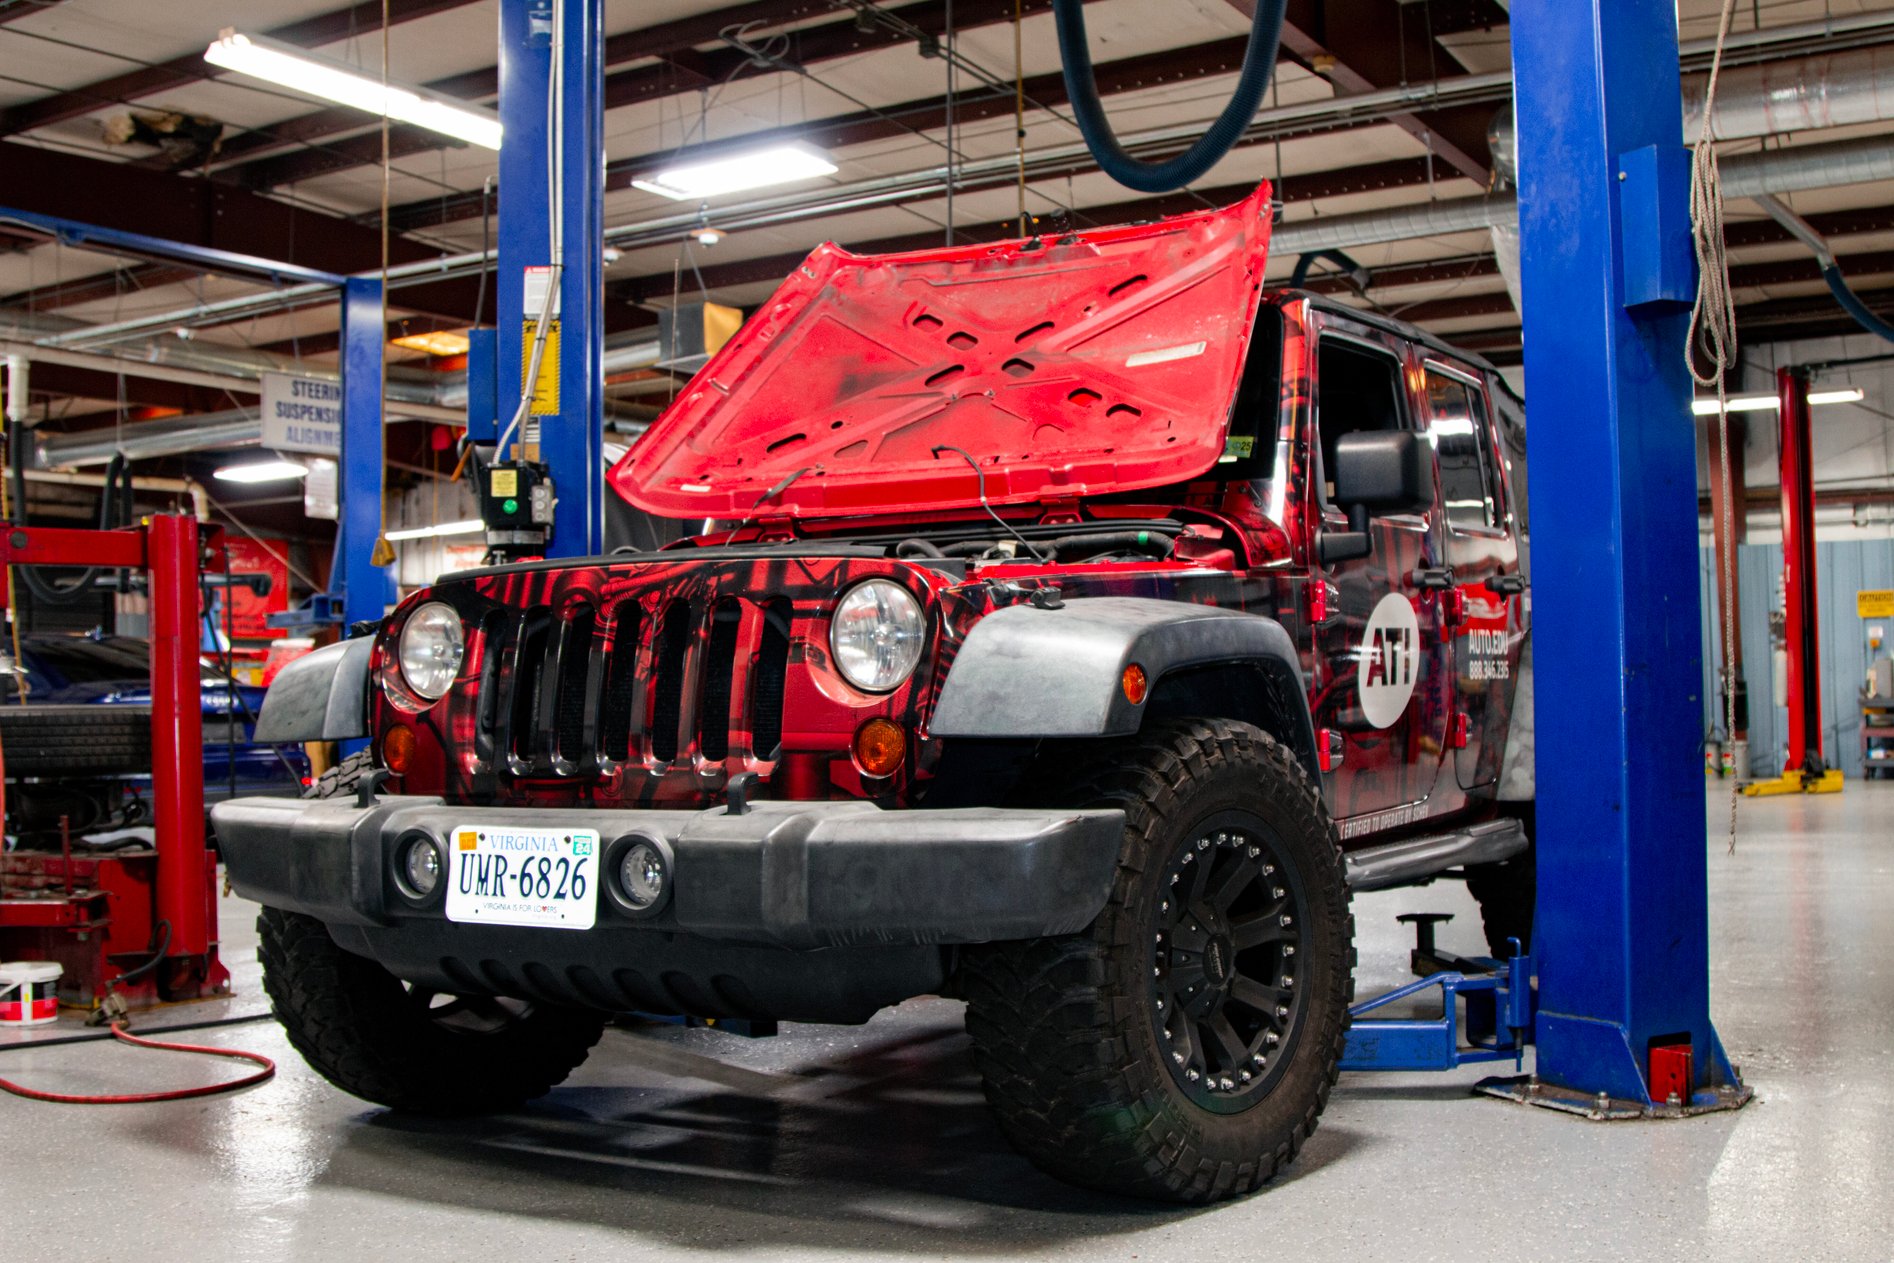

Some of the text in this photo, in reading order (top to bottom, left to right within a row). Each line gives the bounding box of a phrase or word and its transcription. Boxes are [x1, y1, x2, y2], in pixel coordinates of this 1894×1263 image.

[1241, 441, 1252, 451] 25
[1469, 629, 1508, 655] AUTO.EDU
[1366, 628, 1410, 687] ATI
[490, 835, 558, 851] VIRGINIA
[460, 853, 588, 900] UMR-6826
[483, 903, 511, 911] VIRGINIA
[519, 904, 532, 912] FOR
